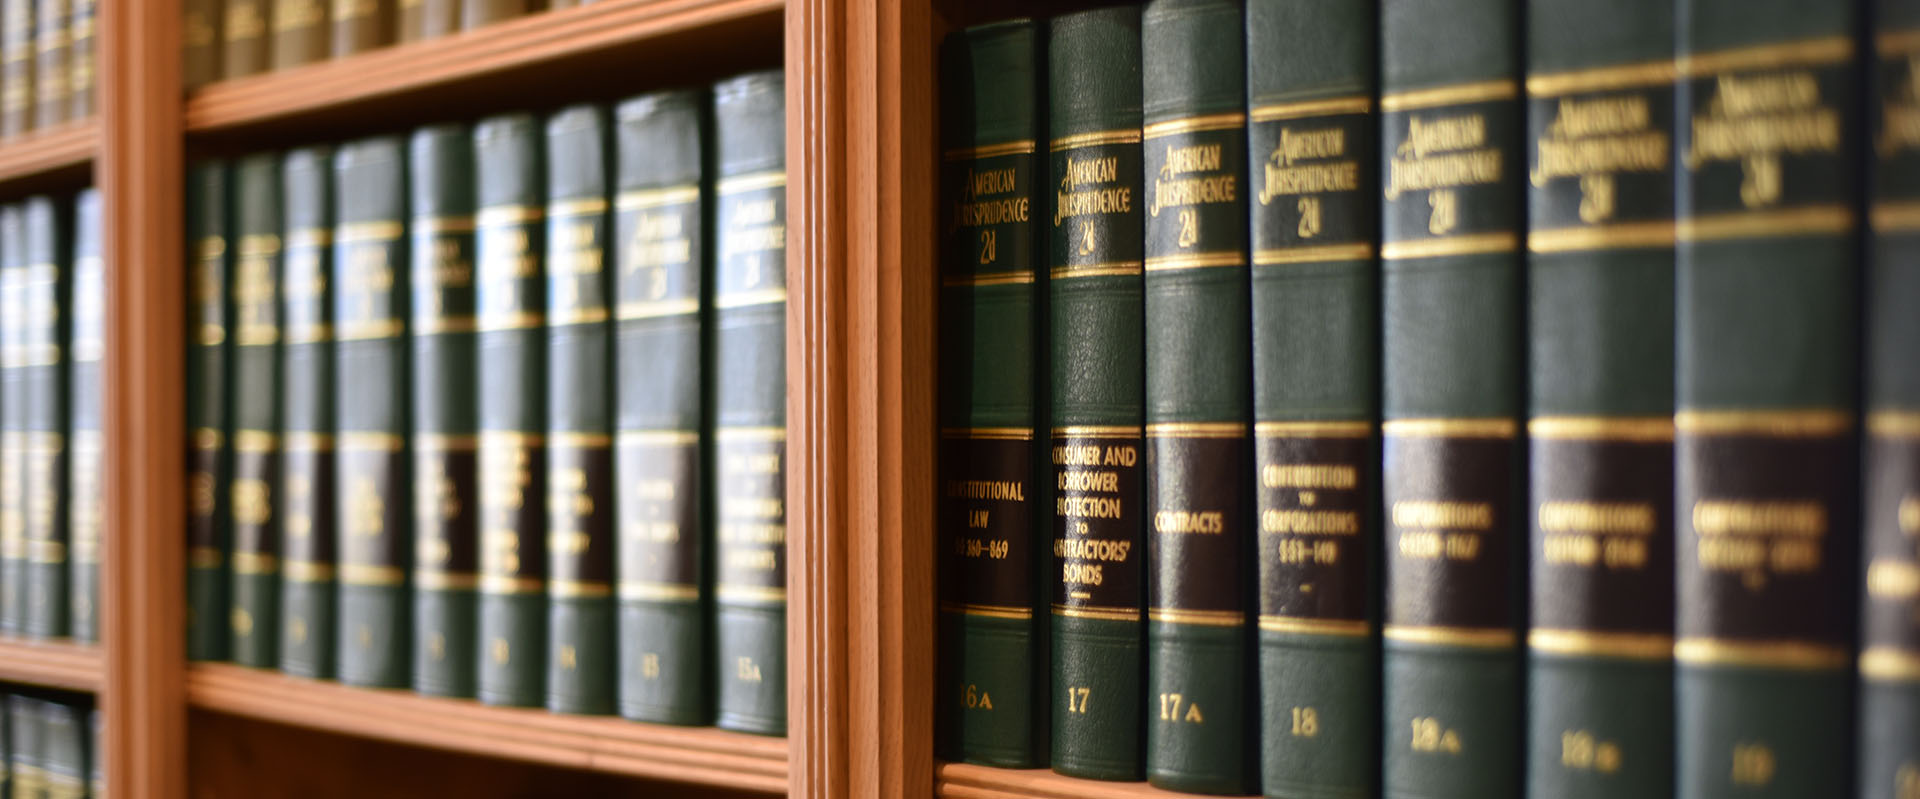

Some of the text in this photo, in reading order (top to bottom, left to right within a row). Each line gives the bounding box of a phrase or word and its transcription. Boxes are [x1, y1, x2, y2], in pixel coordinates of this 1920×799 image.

[1061, 156, 1117, 191] AMERICAN
[1160, 144, 1221, 179] AMERICAN
[962, 167, 1016, 200] AMERICAN
[1151, 176, 1236, 217] JURISPRUDENCE
[1054, 187, 1130, 227] JURISPRUDENCE
[1079, 220, 1095, 255] 2d
[1179, 208, 1197, 247] 2d
[980, 229, 996, 264] 2d
[1052, 446, 1137, 467] CONSUMER AND
[968, 509, 990, 528] LAW
[1076, 522, 1089, 535] TO
[1155, 510, 1222, 533] CONTRACTS
[1063, 563, 1102, 586] BONDS
[1069, 687, 1090, 714] 17
[1292, 706, 1318, 736] 18
